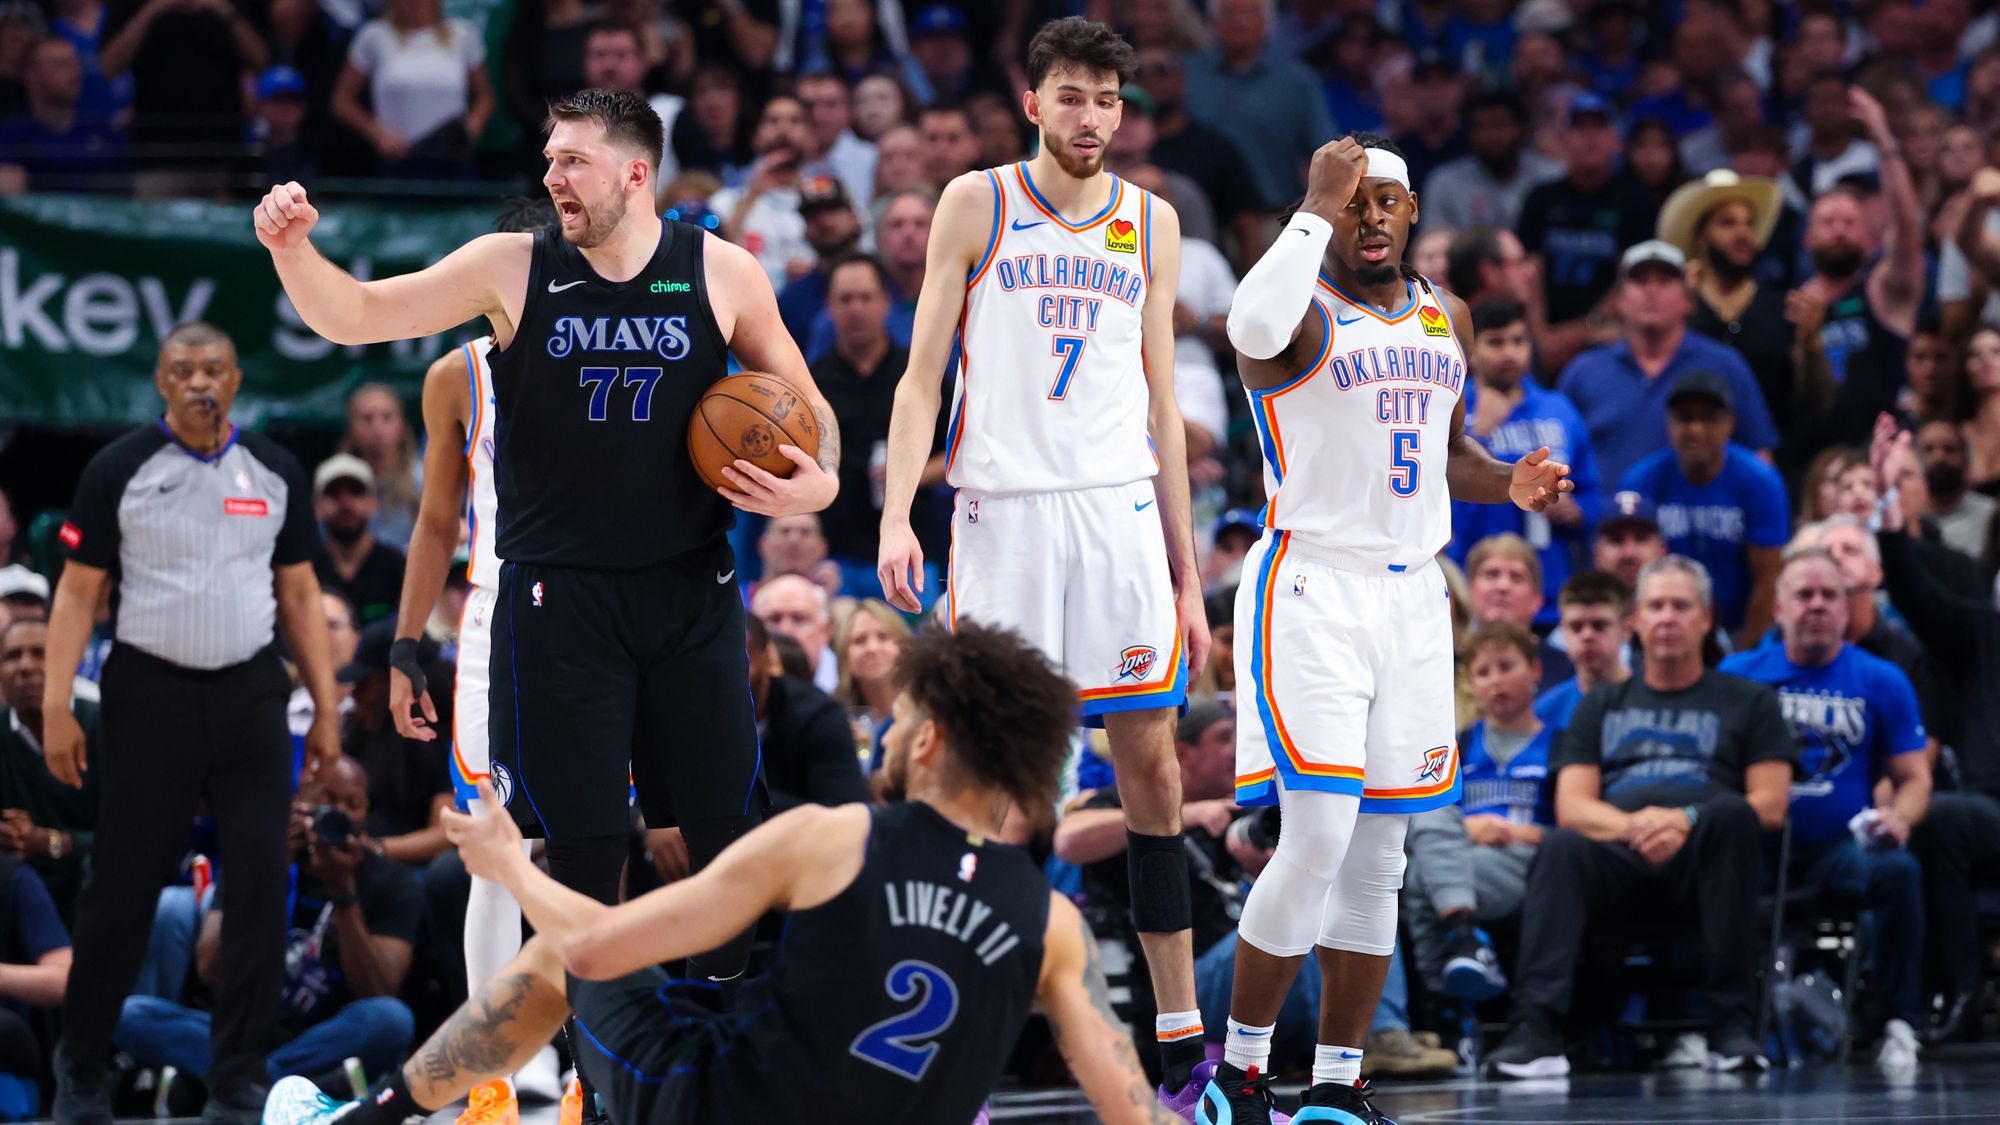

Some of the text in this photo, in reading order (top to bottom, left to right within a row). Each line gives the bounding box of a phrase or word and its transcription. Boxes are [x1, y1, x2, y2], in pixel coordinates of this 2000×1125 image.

[650, 279, 692, 294] chime
[996, 254, 1143, 308] OKLAHOMA
[546, 315, 692, 361] MAVS
[1038, 294, 1103, 332] CITY
[579, 366, 664, 422] 77
[1047, 334, 1088, 401] 7
[1329, 345, 1465, 396] OKLAHOMA
[1376, 388, 1432, 425] CITY
[1388, 429, 1421, 499] 5
[885, 880, 1021, 966] LIVELY II
[849, 958, 961, 1083] 2
